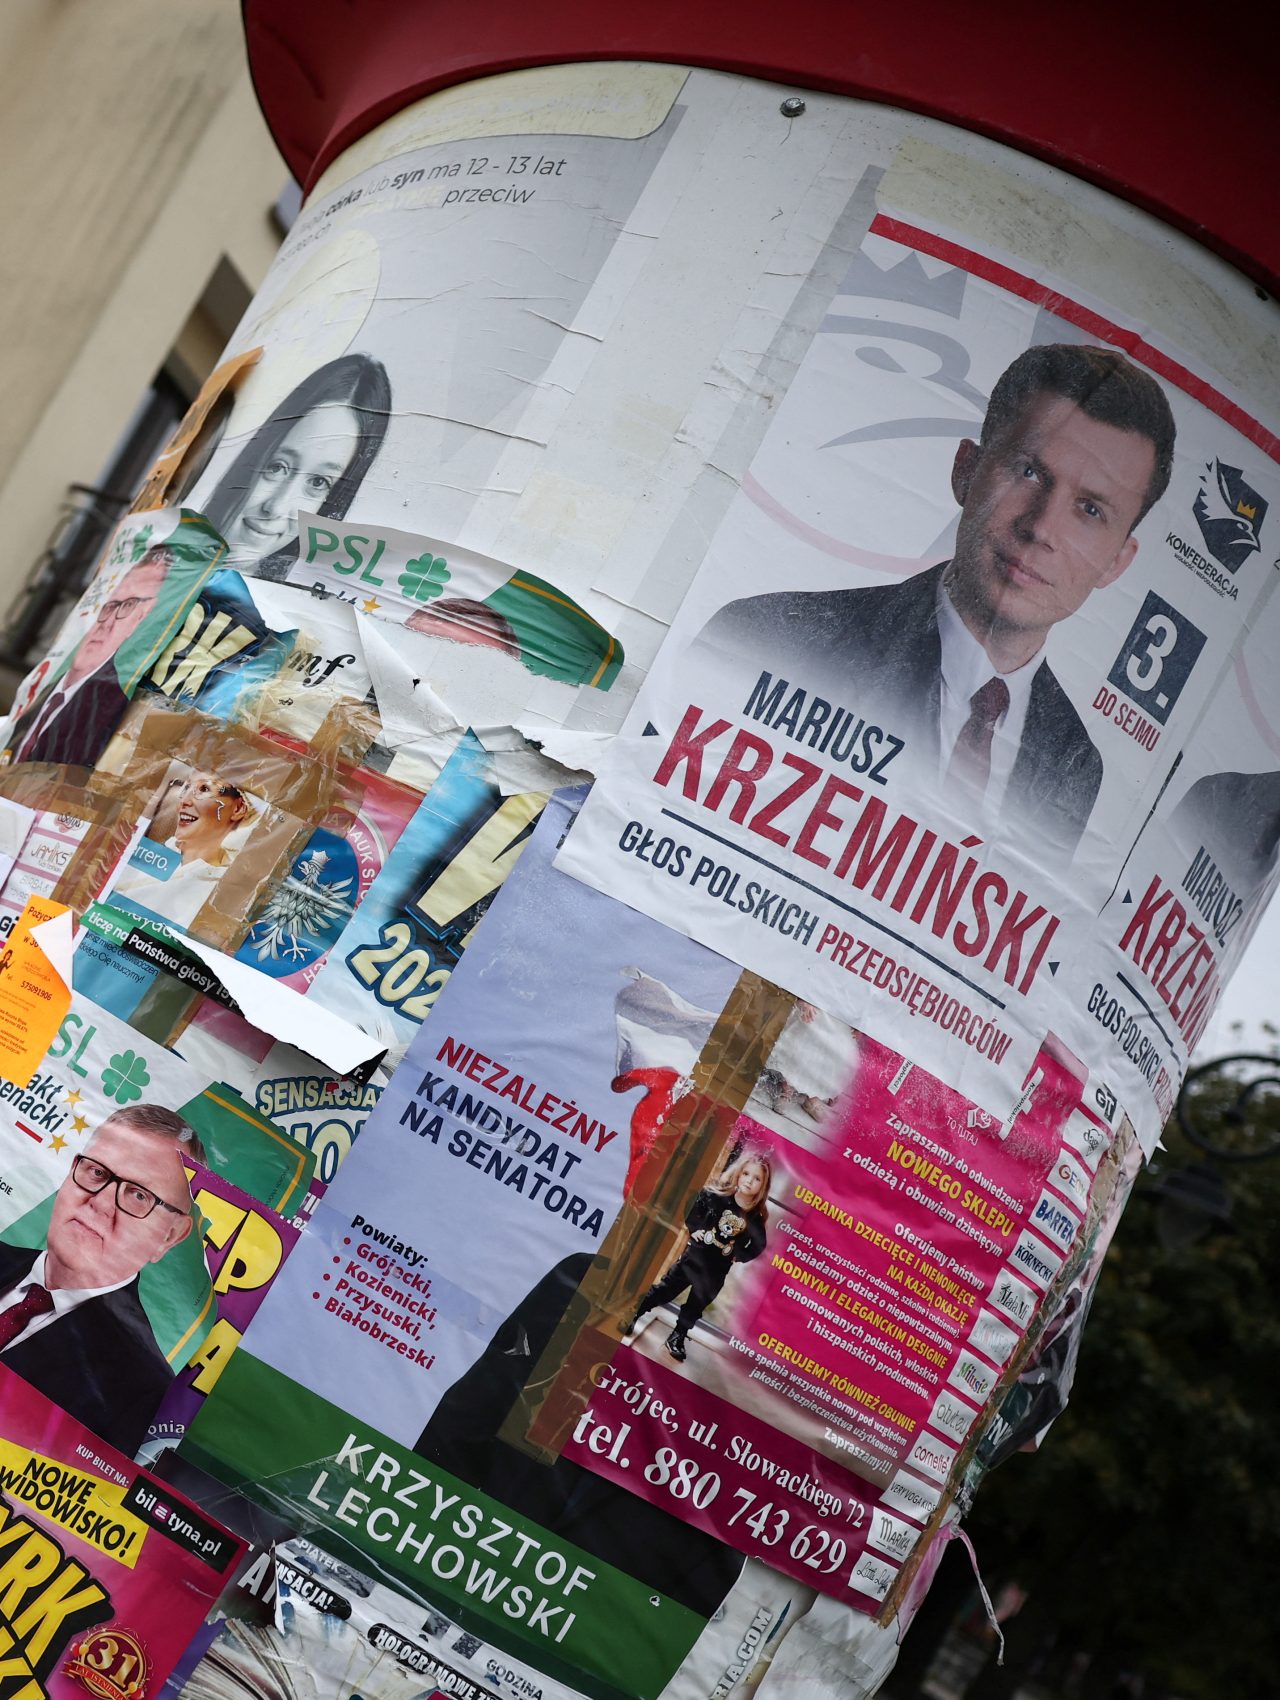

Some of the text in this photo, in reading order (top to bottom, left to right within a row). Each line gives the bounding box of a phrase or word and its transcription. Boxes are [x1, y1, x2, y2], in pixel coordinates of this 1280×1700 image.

[391, 168, 424, 191] syn
[427, 161, 462, 181] ma
[466, 157, 488, 176] 12
[506, 155, 531, 175] 13
[533, 155, 567, 177] lat
[442, 184, 536, 208] przeciw
[305, 526, 386, 587] PSL
[1165, 532, 1240, 601] KONFEDERACJA
[742, 670, 906, 786] MARIUSZ
[1092, 686, 1161, 752] DO SEJMU
[653, 704, 1061, 996] KRZEMIŃSKI
[28, 906, 57, 923] Pożycz
[1181, 845, 1244, 948] MARIUSZ
[88, 911, 113, 935] Liczę
[113, 927, 129, 942] na
[128, 933, 179, 970] Państwa
[178, 963, 216, 993] głosy
[618, 820, 692, 878] GŁOS
[689, 856, 820, 946] POLSKICH
[815, 923, 1014, 1065] PRZEDSIĘBIORCÓW
[20, 980, 53, 1001] 575091906
[1087, 983, 1126, 1036] GŁOS
[26, 1071, 64, 1105] akt
[435, 1036, 619, 1153] NIEZALEŻNY
[946, 1115, 958, 1130] TO
[415, 1071, 582, 1180] KANDYDAT
[399, 1100, 445, 1145] NA
[447, 1129, 606, 1238] SENATORA
[886, 1112, 1024, 1216] Zapraszamy do odwiedzenia
[886, 1140, 1015, 1238] NOWEGO SKLEPU
[853, 1152, 898, 1190] odzieżą
[905, 1186, 956, 1224] obuwiem
[955, 1215, 1004, 1258] dziecięcym
[350, 1214, 429, 1269] Powiaty:
[356, 1243, 432, 1299] Grójecki,
[794, 1185, 854, 1230] UBRANKA
[853, 1222, 914, 1266] DZIECIĘCE
[919, 1262, 976, 1308] NIEMOWLĘCE
[894, 1222, 985, 1291] Oferujemy Państwu
[1014, 1245, 1054, 1284] KORNECKI
[335, 1278, 422, 1342] Przysuski,
[344, 1261, 438, 1330] Kozienicki,
[771, 1254, 828, 1297] MODNYM
[836, 1293, 907, 1343] ELEGANCKIM
[906, 1334, 948, 1369] DESIGNIE
[786, 1242, 846, 1285] Posiadamy
[847, 1277, 879, 1304] odzież
[885, 1303, 953, 1354] niepowtarzalnym,
[886, 1264, 969, 1328] NA KAŻDĄ OKAZJĘ
[324, 1296, 436, 1370] Białobrzeski
[780, 1284, 939, 1385] renomowanych polskich, włoskich
[813, 1321, 878, 1367] hiszpańskich
[876, 1359, 930, 1400] producentów.
[728, 1335, 756, 1358] które
[755, 1351, 789, 1379] spełnia
[789, 1371, 833, 1403] wszystkie
[831, 1394, 859, 1419] normy
[858, 1409, 875, 1427] pod
[748, 1366, 783, 1395] jakości
[787, 1385, 854, 1432] bezpieczeństwa
[758, 1332, 918, 1433] OFERUJEMY RÓWNIEŻ OBUWIE
[958, 1360, 988, 1395] Milusie
[76, 1443, 129, 1488] KUP BILET NA:
[588, 1361, 866, 1528] Grójec, ul. Słowackiego 72
[824, 1426, 893, 1475] Zapraszamy!!!
[23, 1457, 97, 1505] NOWE
[334, 1432, 597, 1598] KRZYSZTOF
[571, 1408, 847, 1574] tel. 880 743 629
[307, 1470, 577, 1644] LECHOWSKI
[87, 1637, 138, 1689] 31
[375, 1628, 478, 1700] HOLOGRAMOWE
[485, 1658, 544, 1700] GODZINA
